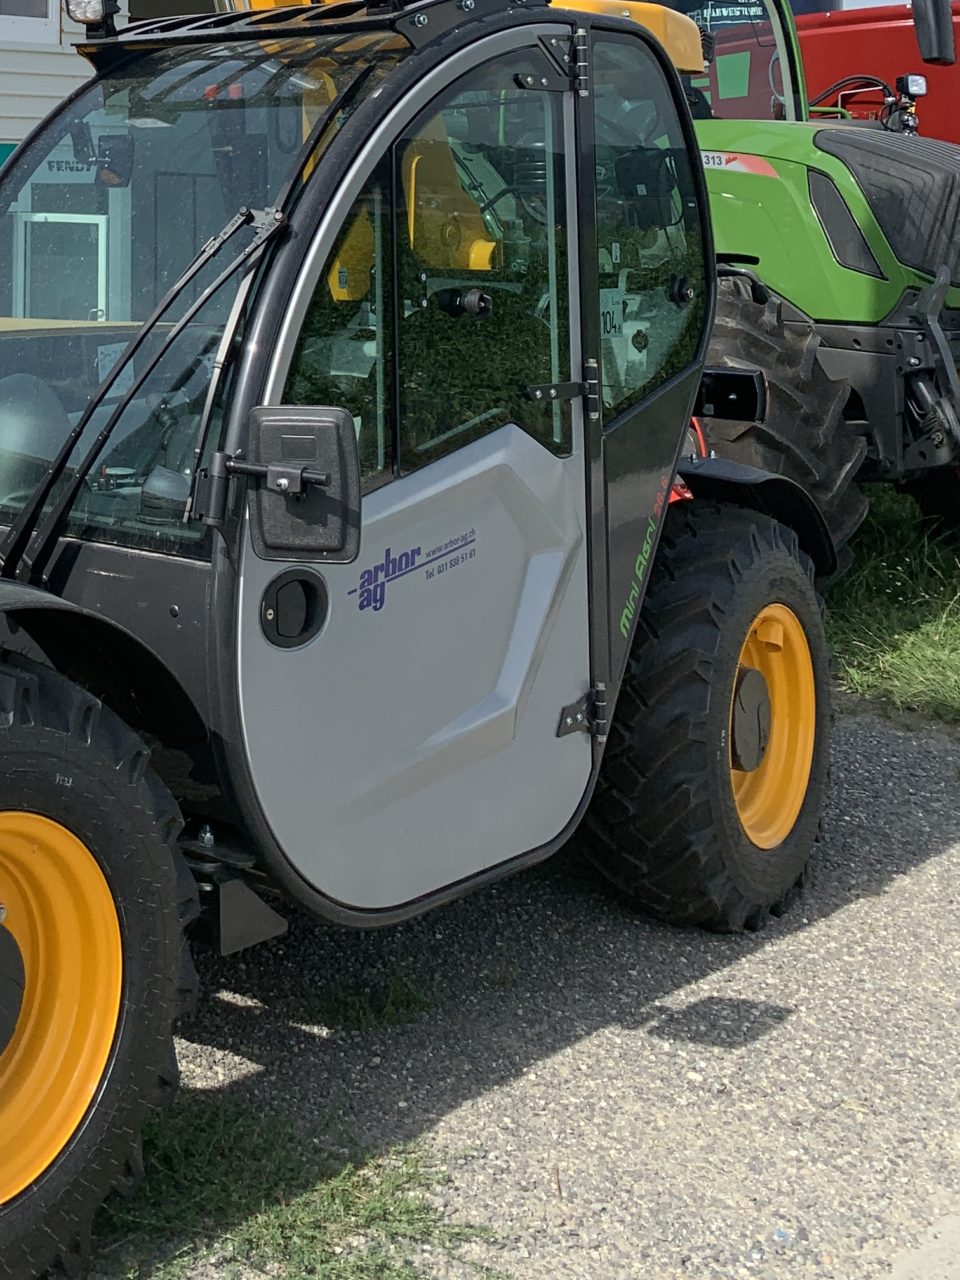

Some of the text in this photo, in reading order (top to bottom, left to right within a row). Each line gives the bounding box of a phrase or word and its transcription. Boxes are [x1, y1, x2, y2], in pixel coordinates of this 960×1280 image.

[703, 154, 723, 166] 313
[359, 546, 422, 591] arbor
[358, 580, 386, 612] ag
